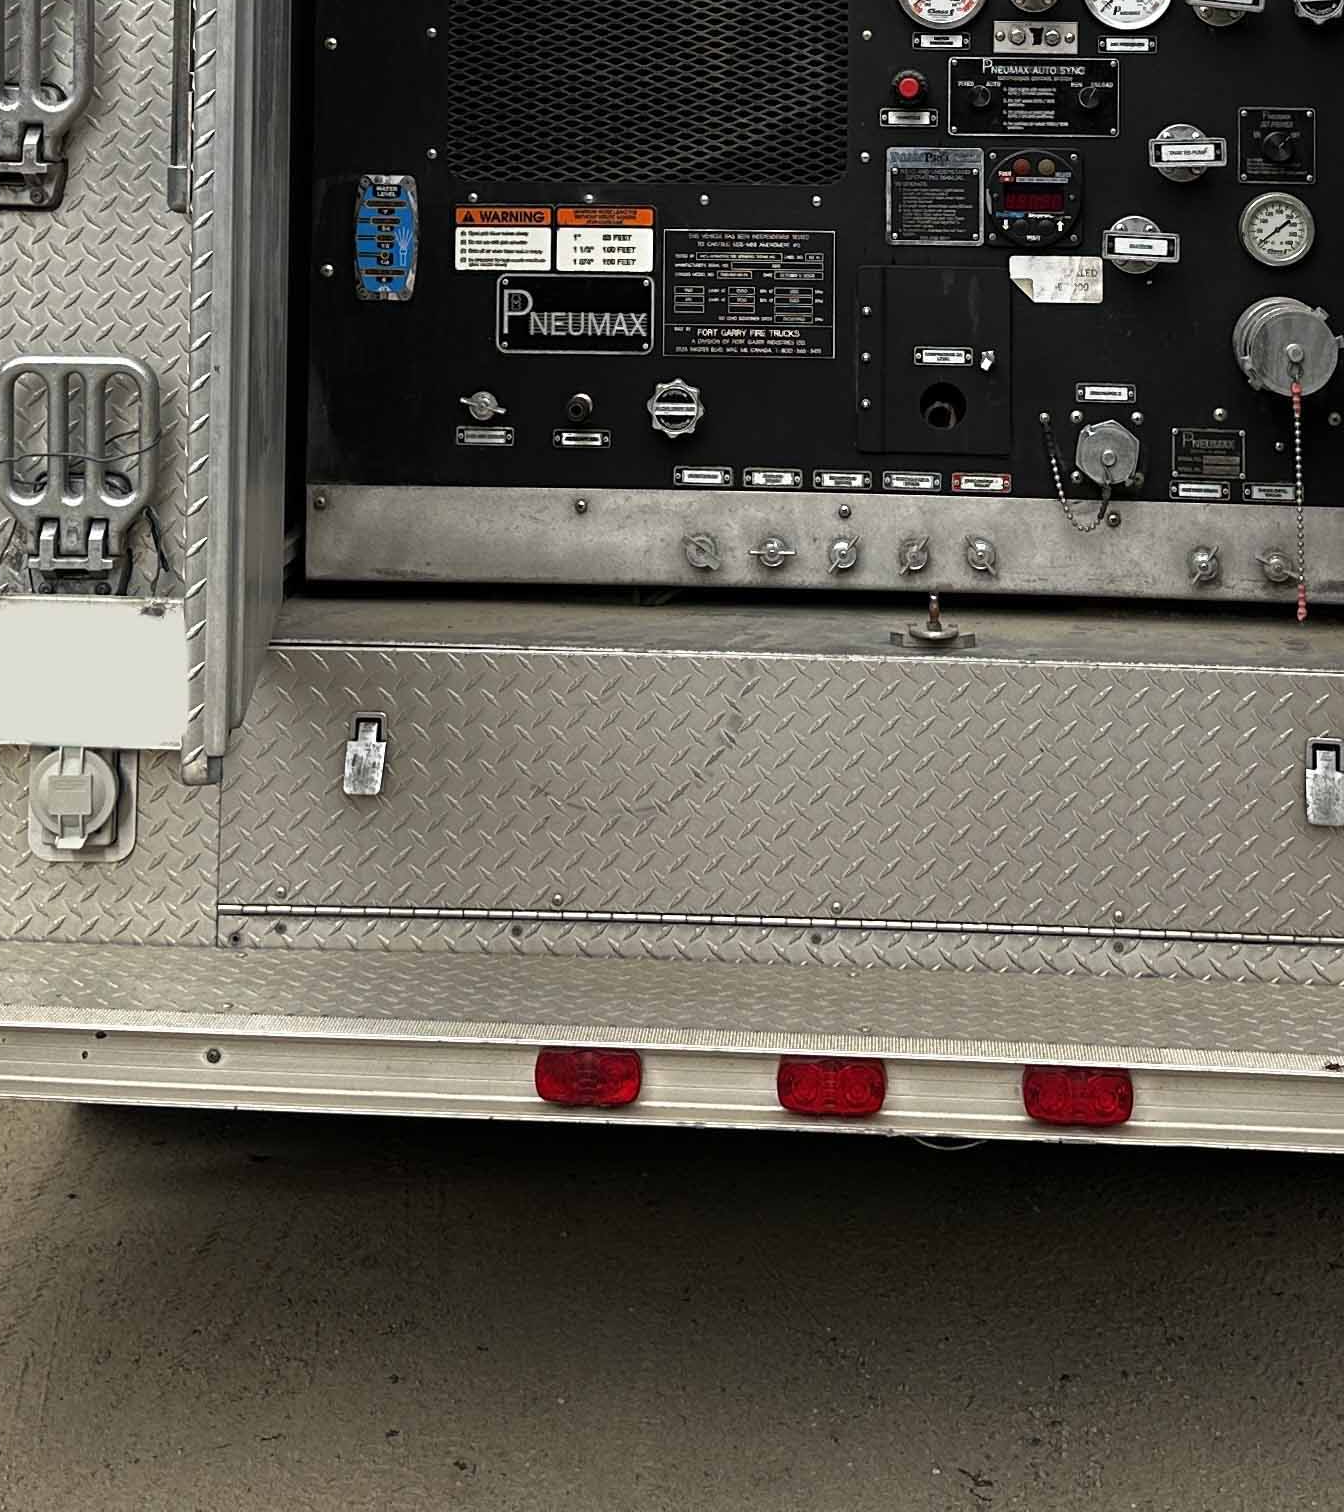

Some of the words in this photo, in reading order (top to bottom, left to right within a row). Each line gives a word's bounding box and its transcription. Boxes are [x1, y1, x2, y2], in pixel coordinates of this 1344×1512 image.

[982, 58, 1030, 75] PNEUMAX
[1032, 66, 1057, 75] AUTO
[1060, 66, 1086, 76] SYNC
[480, 210, 545, 224] WARNING
[612, 234, 632, 242] FEET
[602, 246, 616, 254] 100
[617, 246, 636, 254] FEET
[617, 258, 636, 266] FEET
[503, 288, 648, 337] PNEUMAX
[697, 328, 717, 338] FORT
[720, 328, 747, 338] GARRY
[750, 329, 766, 338] FIRE
[769, 330, 801, 338] TRUCKS
